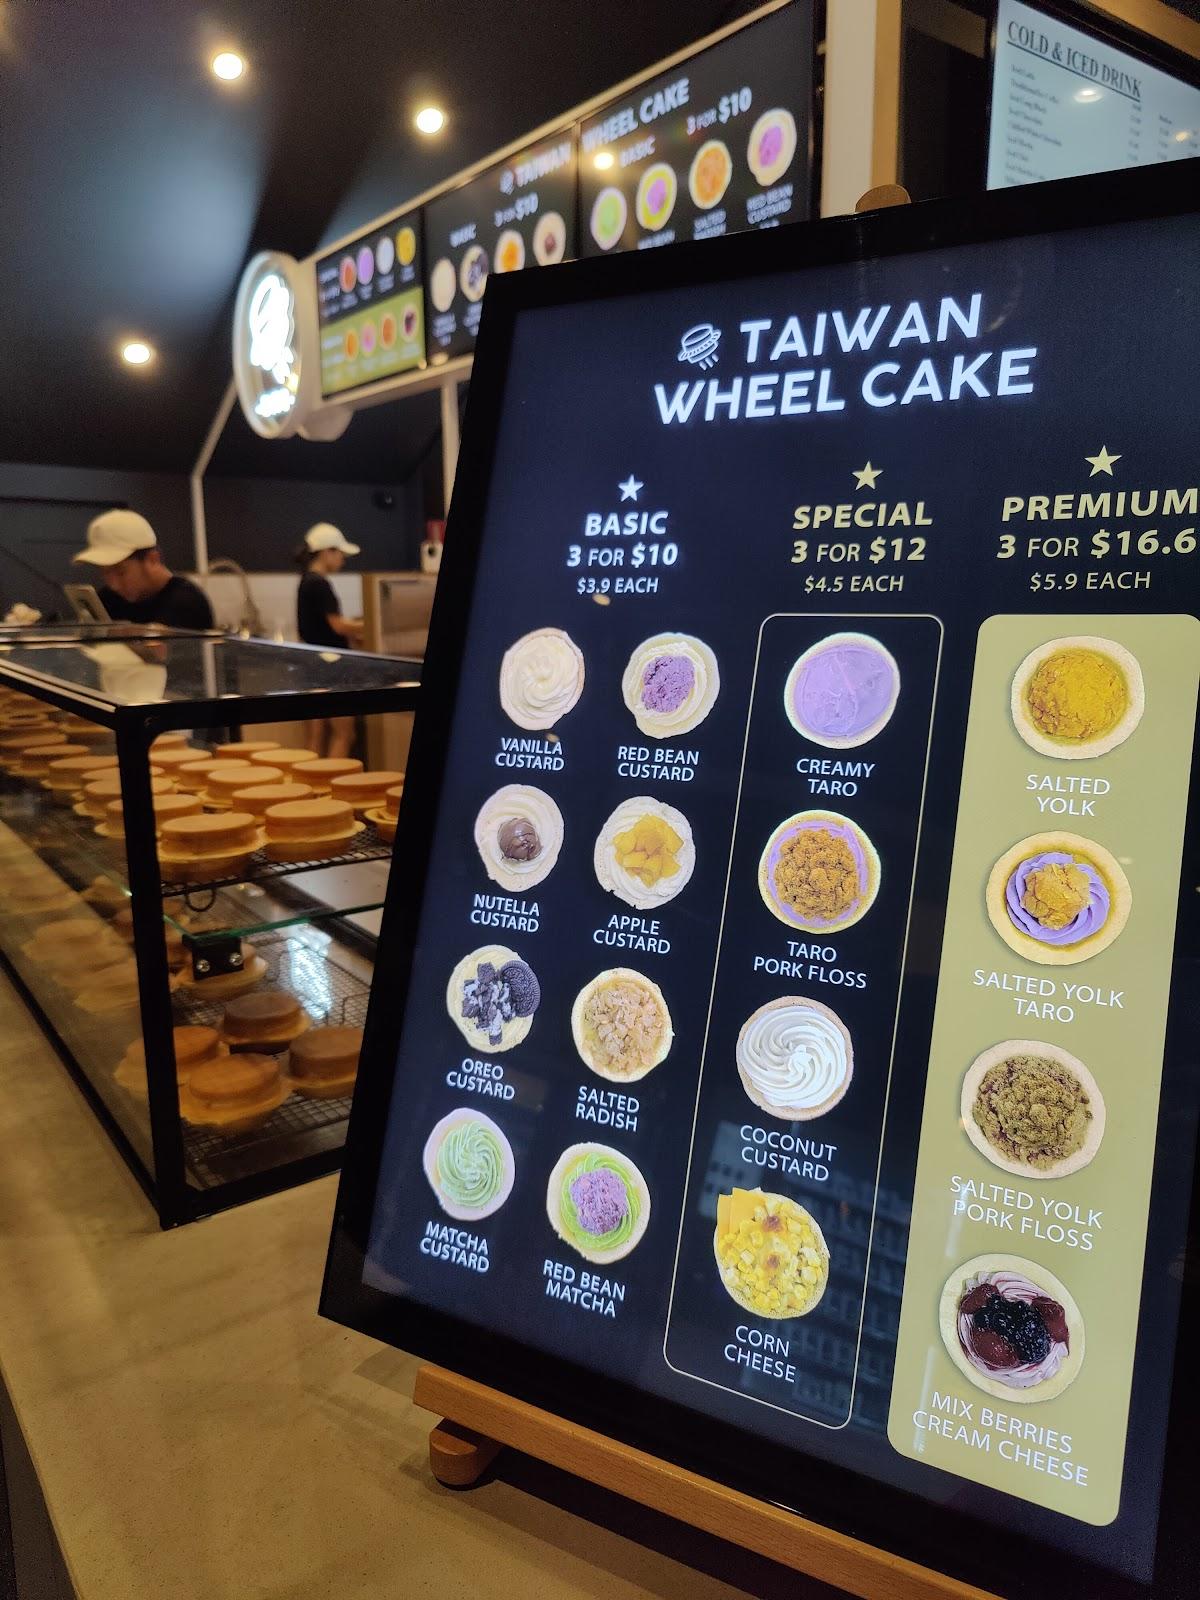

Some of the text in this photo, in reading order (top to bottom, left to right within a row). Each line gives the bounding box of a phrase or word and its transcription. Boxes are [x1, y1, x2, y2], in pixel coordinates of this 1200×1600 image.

[1008, 20, 1050, 54] COLD
[1052, 41, 1062, 62] &
[1066, 47, 1099, 78] ICED
[1102, 63, 1142, 98] DRINK
[639, 77, 690, 124] CAKE
[718, 86, 752, 124] $10
[740, 293, 982, 363] TAIWAN
[654, 347, 1037, 425] WHEEL CAKE
[792, 501, 933, 531] SPECIAL
[1001, 487, 1199, 522] PREMIUM
[584, 510, 669, 537] BASIC
[566, 541, 679, 569] 3 FOR $10
[790, 535, 927, 565] 3 FOR $12
[996, 527, 1197, 560] 3 FOR $16.6
[576, 576, 659, 595] $3.9 EACH
[804, 575, 904, 594] $4.5 EACH
[1029, 571, 1152, 592] $5.9 EACH
[501, 737, 564, 756] VANILLA
[617, 746, 700, 766] RED BEAN
[494, 752, 565, 772] CUSTARD
[617, 762, 695, 782] CUSTARD
[796, 758, 876, 779] CREAMY
[807, 778, 858, 797] TARO
[1025, 774, 1111, 795] SALTED
[1036, 796, 1096, 817] YOLK
[473, 893, 540, 917] NUTELLA
[470, 909, 540, 933] CUSTARD
[607, 914, 660, 936] APPLE
[593, 929, 671, 955] CUSTARD
[787, 940, 837, 963] TARO
[753, 956, 867, 989] PORK FLOSS
[973, 969, 1125, 1009] SALTED YOLK
[1013, 997, 1074, 1023] TARO
[461, 1058, 504, 1079] OREO
[446, 1071, 516, 1101] CUSTARD
[577, 1085, 640, 1113] SALTED
[575, 1102, 638, 1133] RADISH
[740, 1125, 837, 1162] COCONUT
[741, 1147, 829, 1182] CUSTARD
[950, 1175, 1103, 1230] SALTED YOLK
[425, 1221, 489, 1255] MATCHA
[953, 1199, 1093, 1251] PORK FLOSS
[419, 1237, 490, 1273] CUSTARD
[542, 1259, 626, 1301] RED BEAN
[545, 1279, 616, 1318] MATCHA
[735, 1325, 790, 1358] CORN
[724, 1344, 797, 1383] CHEESE
[931, 1391, 1073, 1454] MIX BERRIES
[912, 1410, 1089, 1487] CREAM CHEESE
